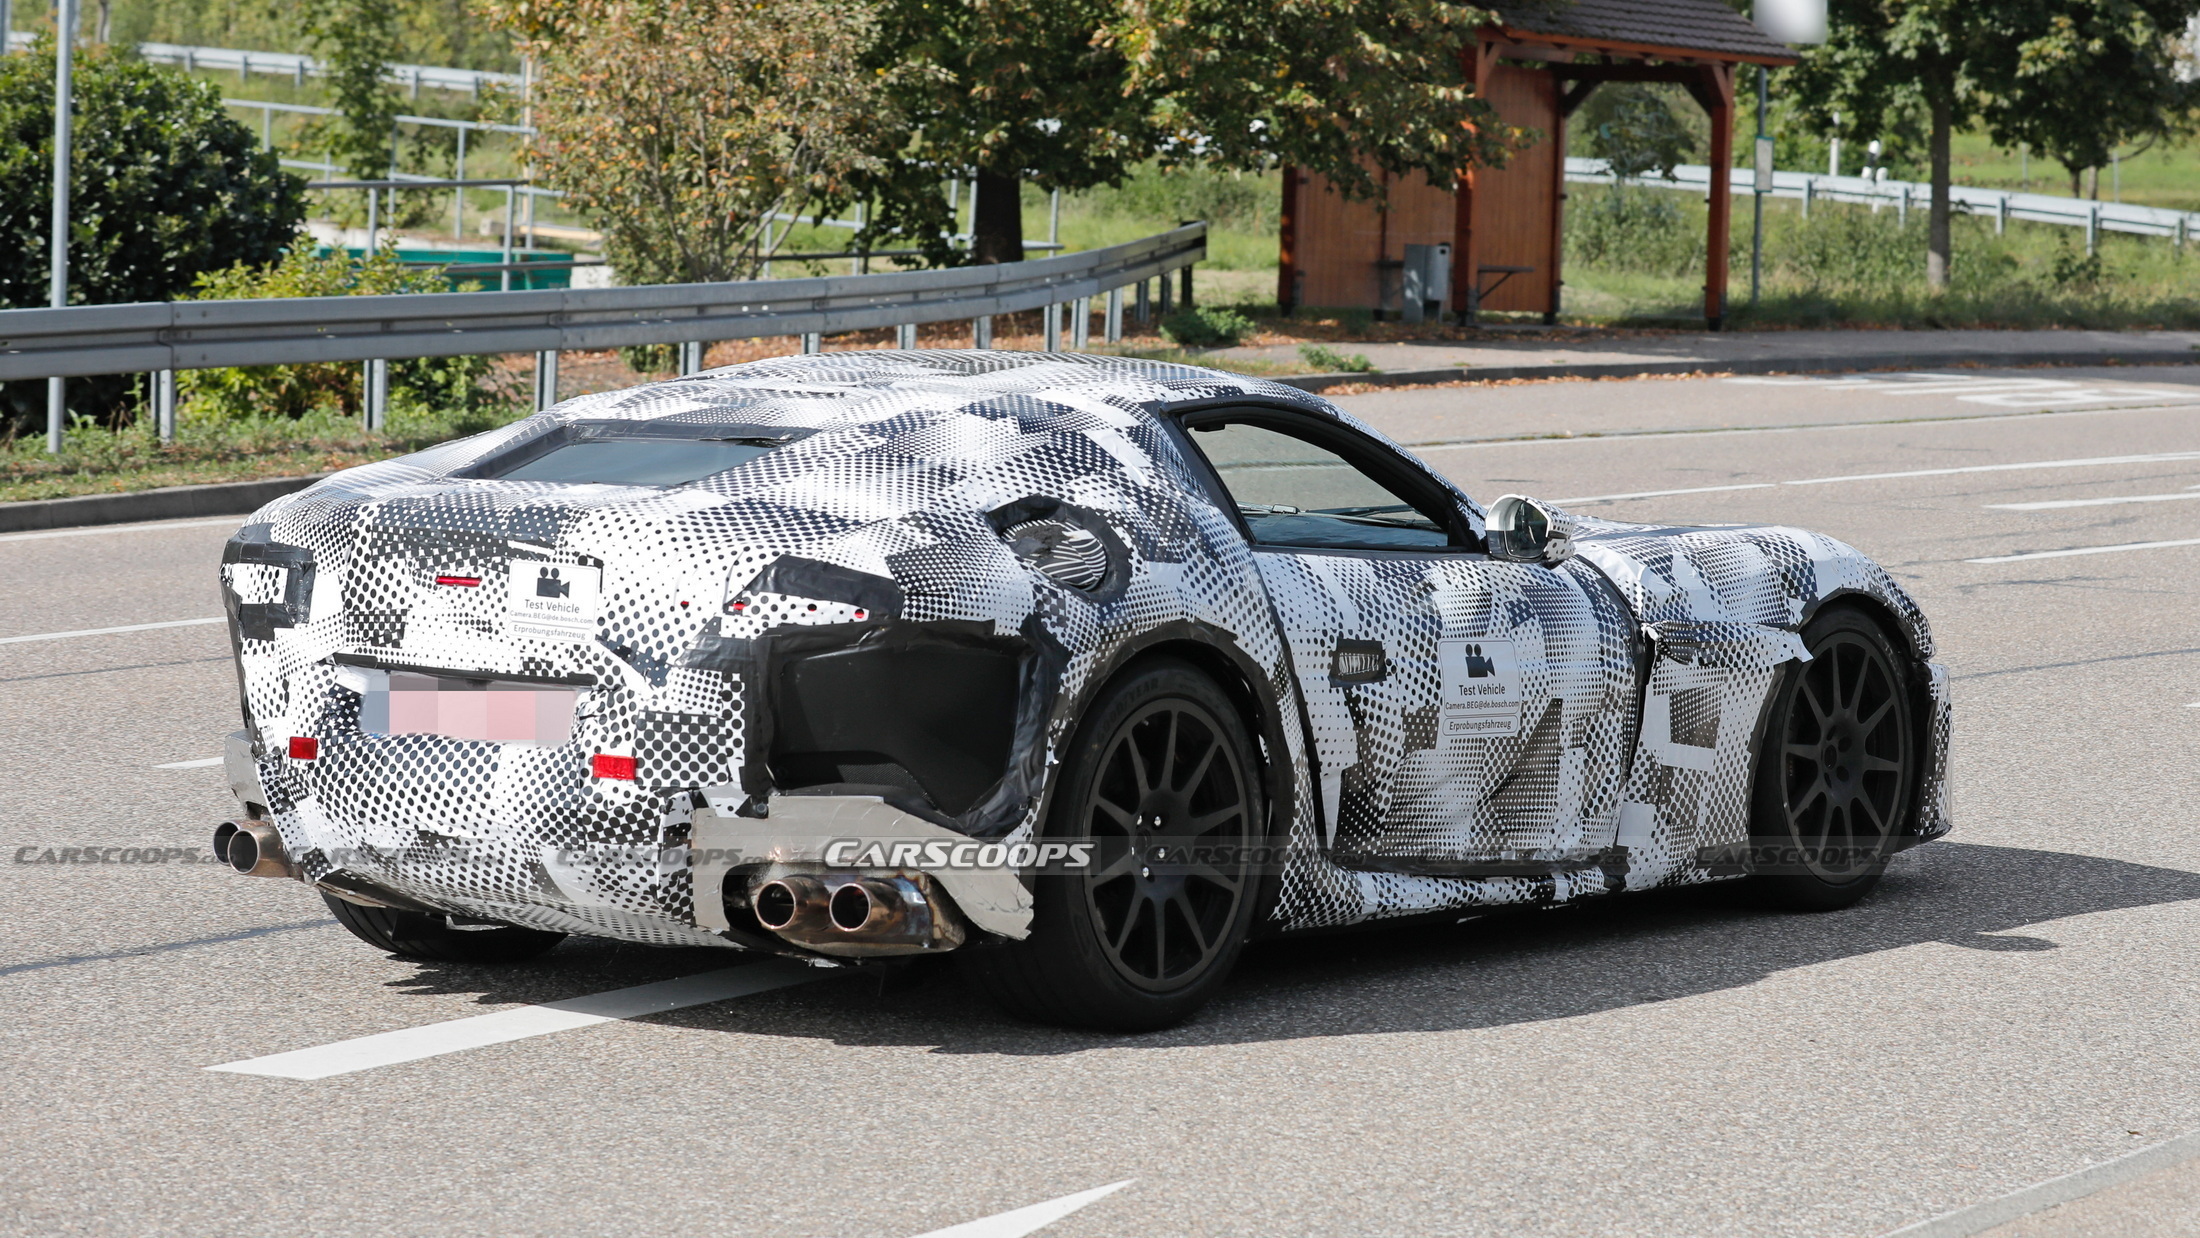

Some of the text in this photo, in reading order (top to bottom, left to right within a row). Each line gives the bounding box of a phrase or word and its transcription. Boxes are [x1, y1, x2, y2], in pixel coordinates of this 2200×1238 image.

[524, 598, 580, 614] Test Vehicle
[509, 610, 594, 624] Camera.BEG@de.bosch.com
[513, 624, 586, 640] Erprobungsfahrzeug
[1458, 683, 1506, 696] Test Vehicle
[1445, 700, 1520, 710] Camera.BEG@de.bosch.com
[1449, 719, 1512, 732] Erprobungsfahrzeug
